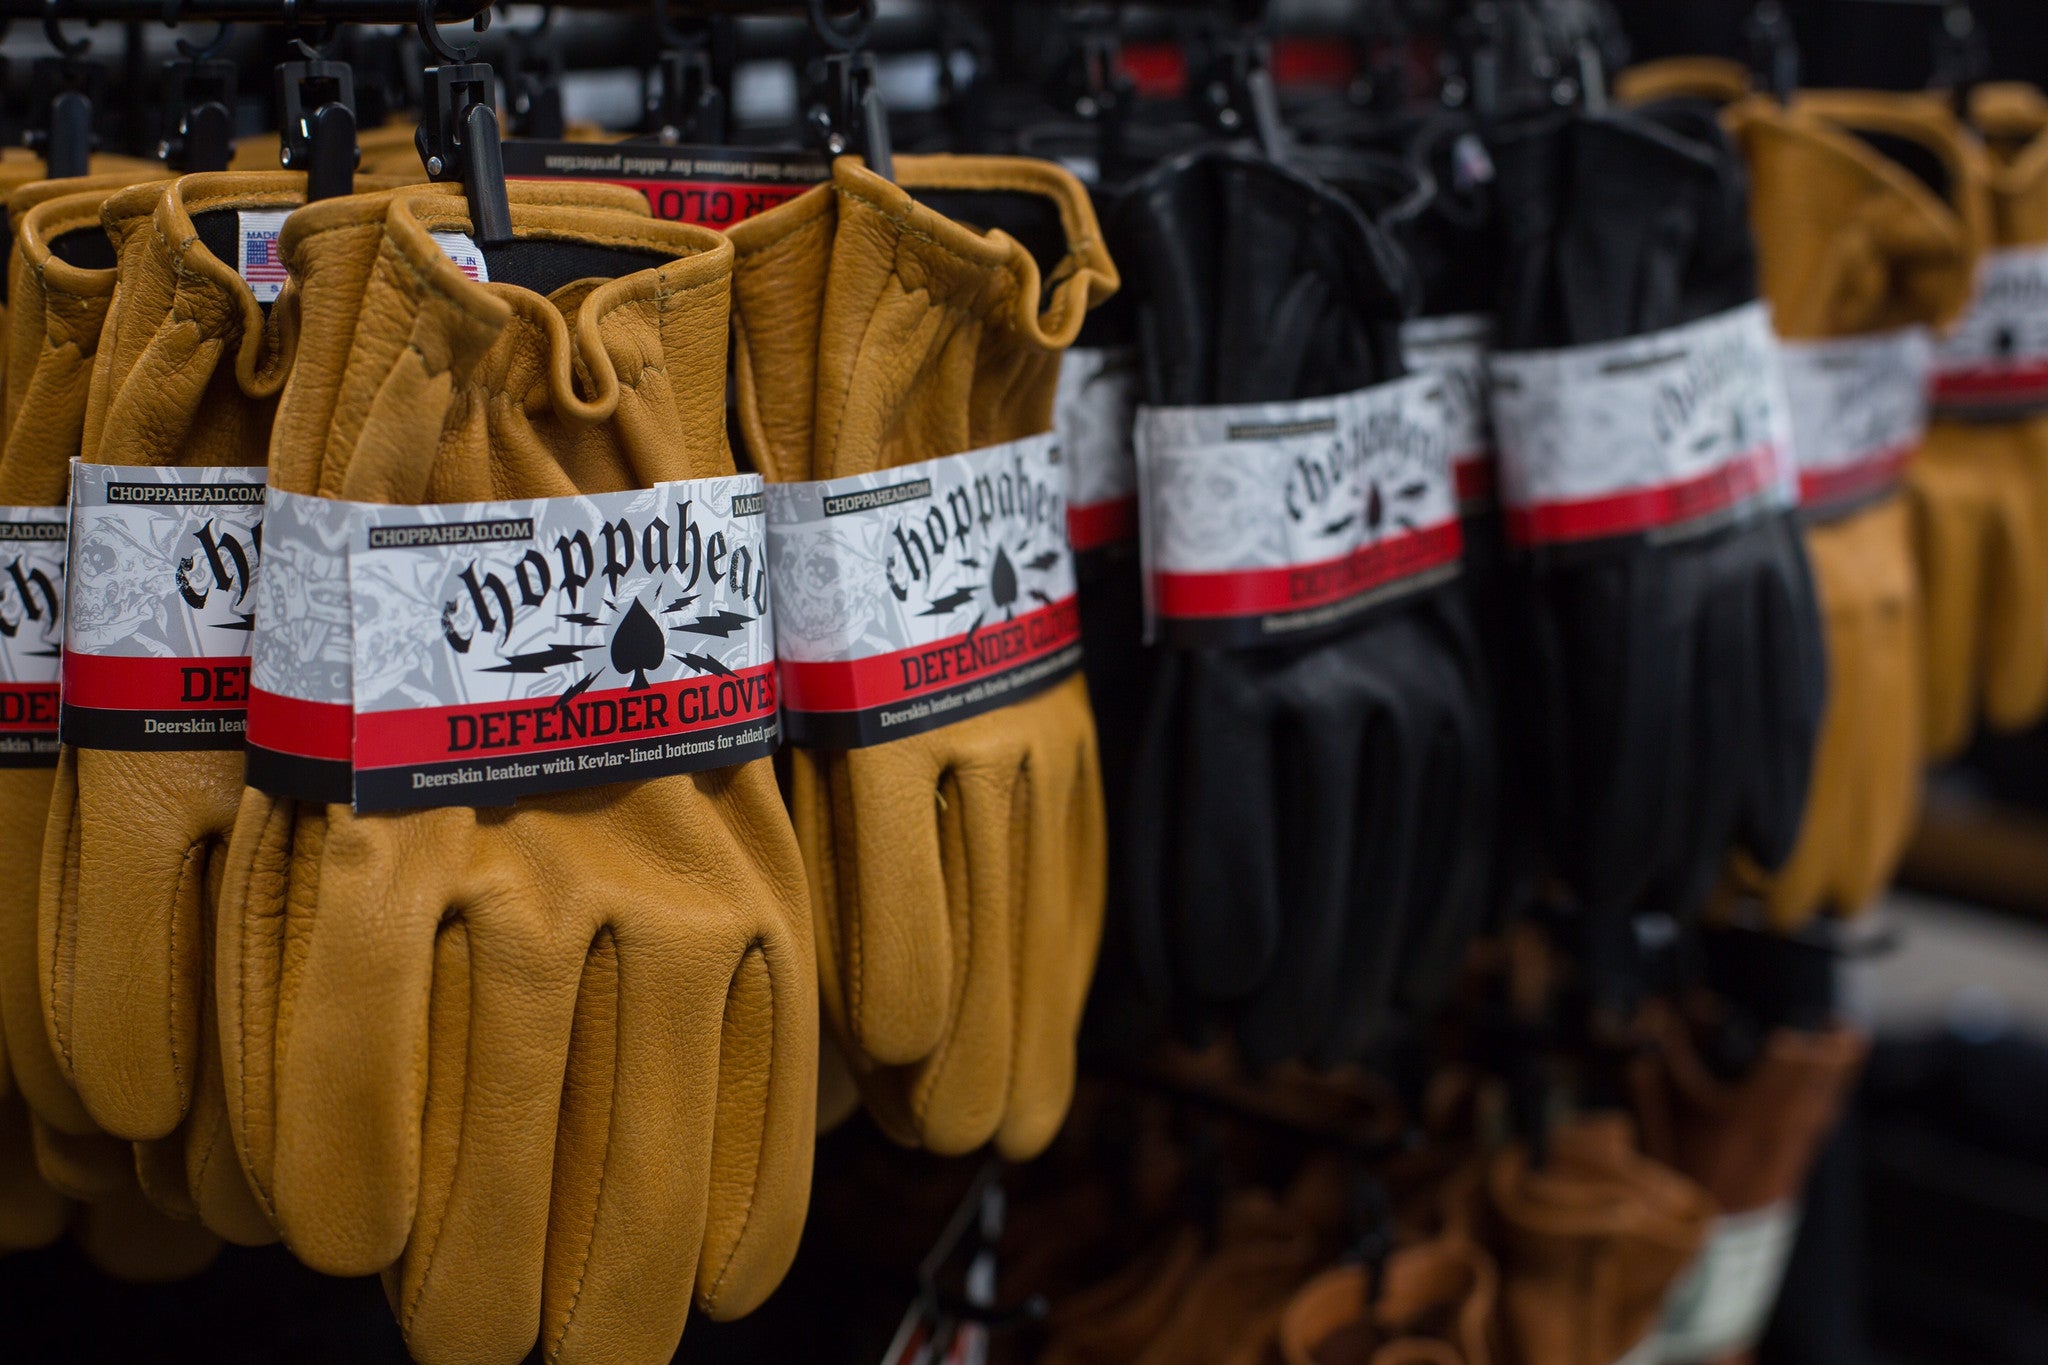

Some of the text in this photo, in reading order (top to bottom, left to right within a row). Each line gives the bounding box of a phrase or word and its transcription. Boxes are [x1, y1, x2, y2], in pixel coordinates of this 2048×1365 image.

[109, 486, 266, 502] CHOPPAHEAD.COM
[826, 480, 931, 514] CHOPPAHEAD.COM
[371, 521, 531, 547] CHOPPAHEAD.COM
[901, 624, 1027, 691] DEFENDER
[144, 718, 216, 733] Deerskin
[447, 671, 774, 752] DEFENDER GLOVES
[412, 766, 483, 789] Deerskin
[486, 762, 540, 781] leather
[542, 757, 576, 775] with
[578, 744, 663, 770] Kevlar-lined
[666, 738, 715, 758] bottoms
[717, 733, 734, 750] for
[736, 726, 763, 746] added
